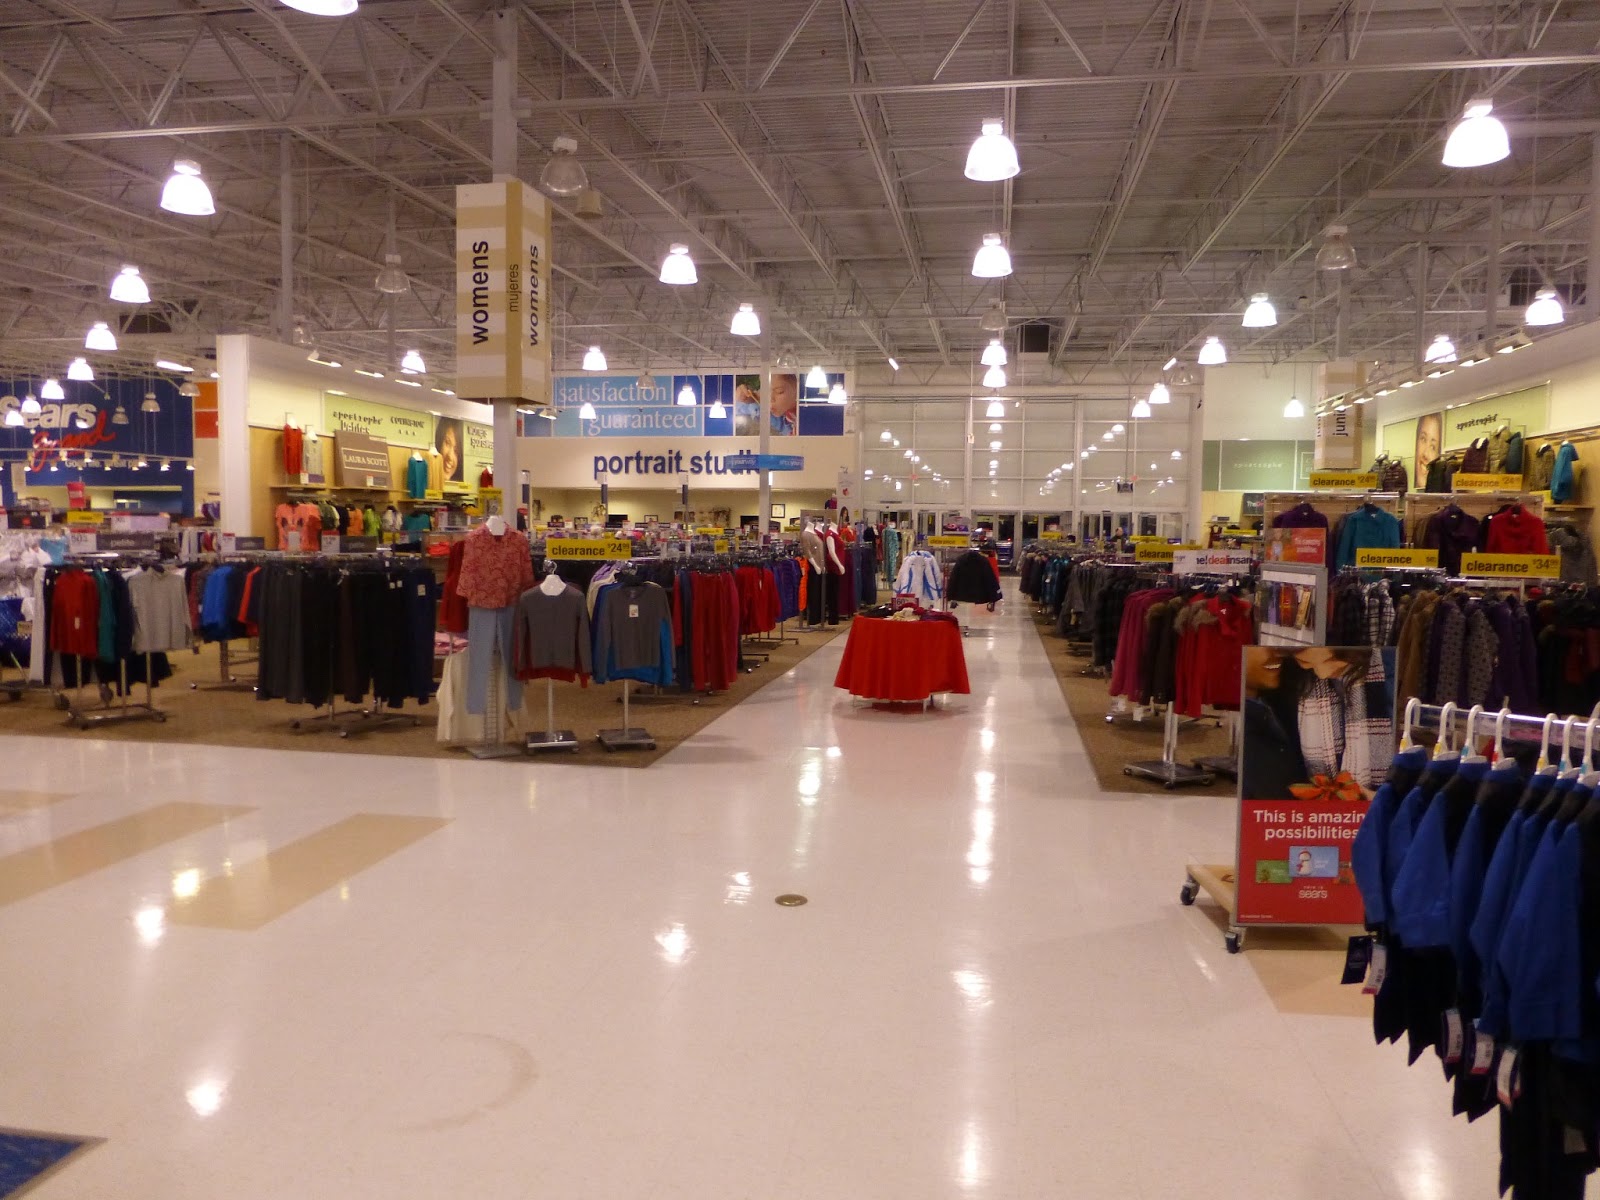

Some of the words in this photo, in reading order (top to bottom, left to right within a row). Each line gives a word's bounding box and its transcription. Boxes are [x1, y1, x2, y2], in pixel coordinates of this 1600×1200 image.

[472, 240, 489, 345] womens
[507, 263, 522, 313] mujeres
[530, 244, 540, 347] womens
[558, 381, 666, 403] satisfaction
[588, 407, 697, 436] guaranteed
[1331, 405, 1349, 437] juni
[594, 449, 684, 480] portrait
[1312, 478, 1356, 486] clearance
[1455, 478, 1500, 487] clearance
[551, 547, 606, 556] clearance
[1138, 550, 1174, 559] clearan
[1360, 555, 1413, 564] clearance
[1466, 559, 1528, 573] clearance
[1253, 810, 1286, 824] This
[1291, 811, 1304, 823] is
[1308, 811, 1365, 824] amazin
[1264, 826, 1360, 841] possibilities
[1298, 889, 1328, 899] sears
